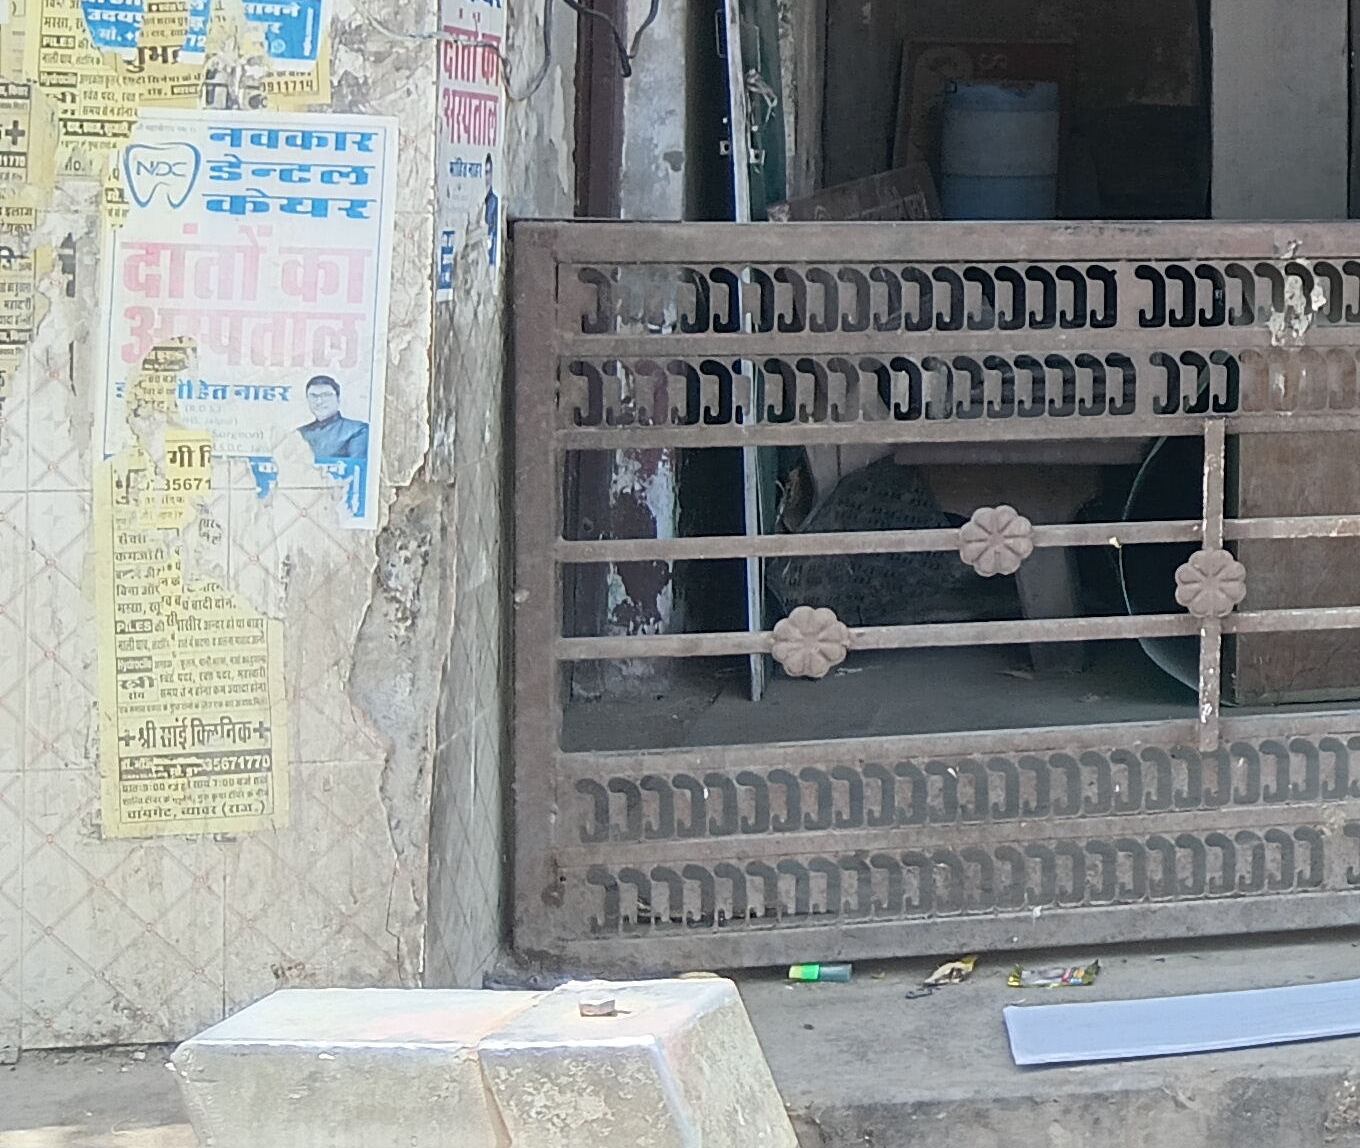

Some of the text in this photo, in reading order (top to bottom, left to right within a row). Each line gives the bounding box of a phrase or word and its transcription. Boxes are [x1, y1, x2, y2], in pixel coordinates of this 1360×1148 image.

[443, 87, 500, 149] अस्पताल
[208, 126, 379, 153] नवकार
[207, 153, 376, 186] डेन्टल
[202, 187, 377, 220] केयर
[120, 222, 372, 304] दांतों का
[233, 385, 292, 403] नाहर
[117, 620, 152, 633] PILES
[138, 720, 156, 750] श्री
